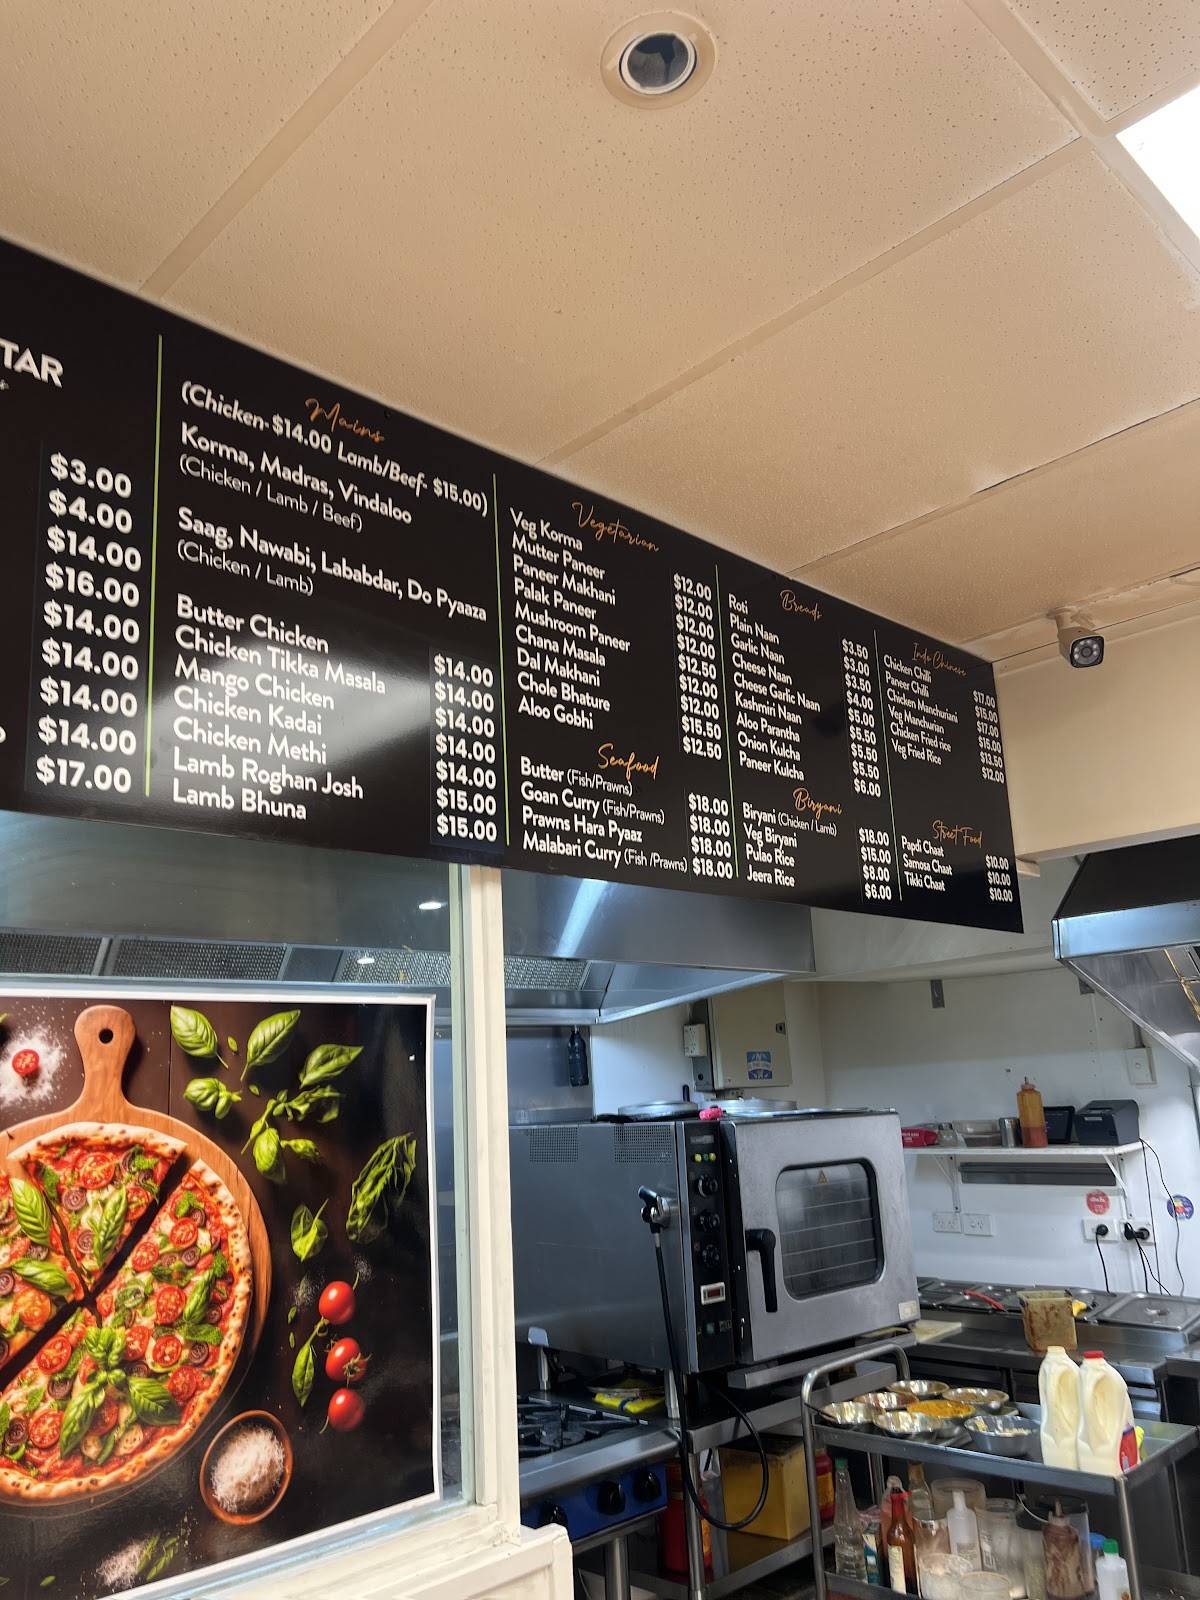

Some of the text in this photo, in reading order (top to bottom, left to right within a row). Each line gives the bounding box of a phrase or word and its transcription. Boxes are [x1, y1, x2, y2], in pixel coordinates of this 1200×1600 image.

[305, 398, 384, 443] Mains
[50, 452, 131, 498] $3.00
[180, 454, 362, 532] (Chicken Lamb Beef)
[182, 422, 412, 524] Korma, Madras, Vindaloo
[433, 477, 488, 517] $15.00)
[49, 488, 132, 533] $4.00
[572, 502, 659, 552] Vegetarian
[47, 525, 141, 572] $14.00
[178, 539, 313, 596] (Chicken Lamb)
[179, 507, 486, 621] Saag, Nawabi, Lababdar, Do Pyaaza
[510, 507, 711, 601] Veg Korma $12.00
[512, 531, 713, 621] Mutter Paneer $12.00
[45, 562, 139, 607] $16.00
[513, 554, 714, 640] Paneer Makhani $12.00
[44, 599, 140, 644] $14.00
[177, 593, 493, 687] Butter Chicken $14.00
[514, 577, 715, 660] Palak Paneer $12.00
[515, 600, 716, 680] Mushroom Paneer $12.50
[729, 593, 868, 660] Roti $3.50
[730, 612, 870, 677] Plain Naan $3.00
[42, 637, 139, 680] $14.00
[175, 625, 494, 713] Chicken Tikka Masala $14.00
[516, 624, 718, 700] Chana Masala $12.00
[517, 647, 719, 720] Dal Makhani $12.00
[731, 633, 871, 694] Garlic Naan $3.50
[732, 652, 873, 711] Cheese Naan $4.00
[40, 675, 137, 717] $14.00
[175, 653, 495, 738] Mango Chicken $14.00
[518, 671, 721, 740] Chole Bhature $15.50
[734, 672, 875, 728] Cheese Garlic Naan $5.00
[735, 690, 876, 745] Kashmiri Naan $5.50
[38, 714, 136, 755] $14.00
[173, 716, 496, 790] Chicken Methi $14.00
[174, 686, 495, 764] Chicken Kadai $14.00
[518, 695, 722, 760] Aloo Gobhi $12.50
[736, 711, 878, 763] Aloo Parantha $5.50
[36, 754, 131, 793] $17.00
[174, 746, 496, 816] Lamb Roghan Josh $15.00
[598, 743, 659, 781] Seafood
[738, 731, 879, 780] Onion Kulcha $5.50
[739, 750, 881, 797] Paneer Kulcha $6.00
[173, 778, 497, 842] Lamb Bhuna $15.00
[521, 756, 729, 816] Butter (Fish/Prawns) $18.00
[521, 781, 730, 837] Goan Curry (Fish/Prawns) $18.00
[793, 788, 842, 820] Biryani
[523, 805, 731, 858] Prawns Hara Pyaaz $18.00
[743, 802, 889, 846] Biryani $18.00
[743, 822, 891, 864] Veg Biryani $15.00
[523, 830, 733, 879] Malabari Curry $18.00
[746, 843, 890, 882] Pulao Rice $8.00
[747, 864, 892, 900] Jeera Rice $6.00
